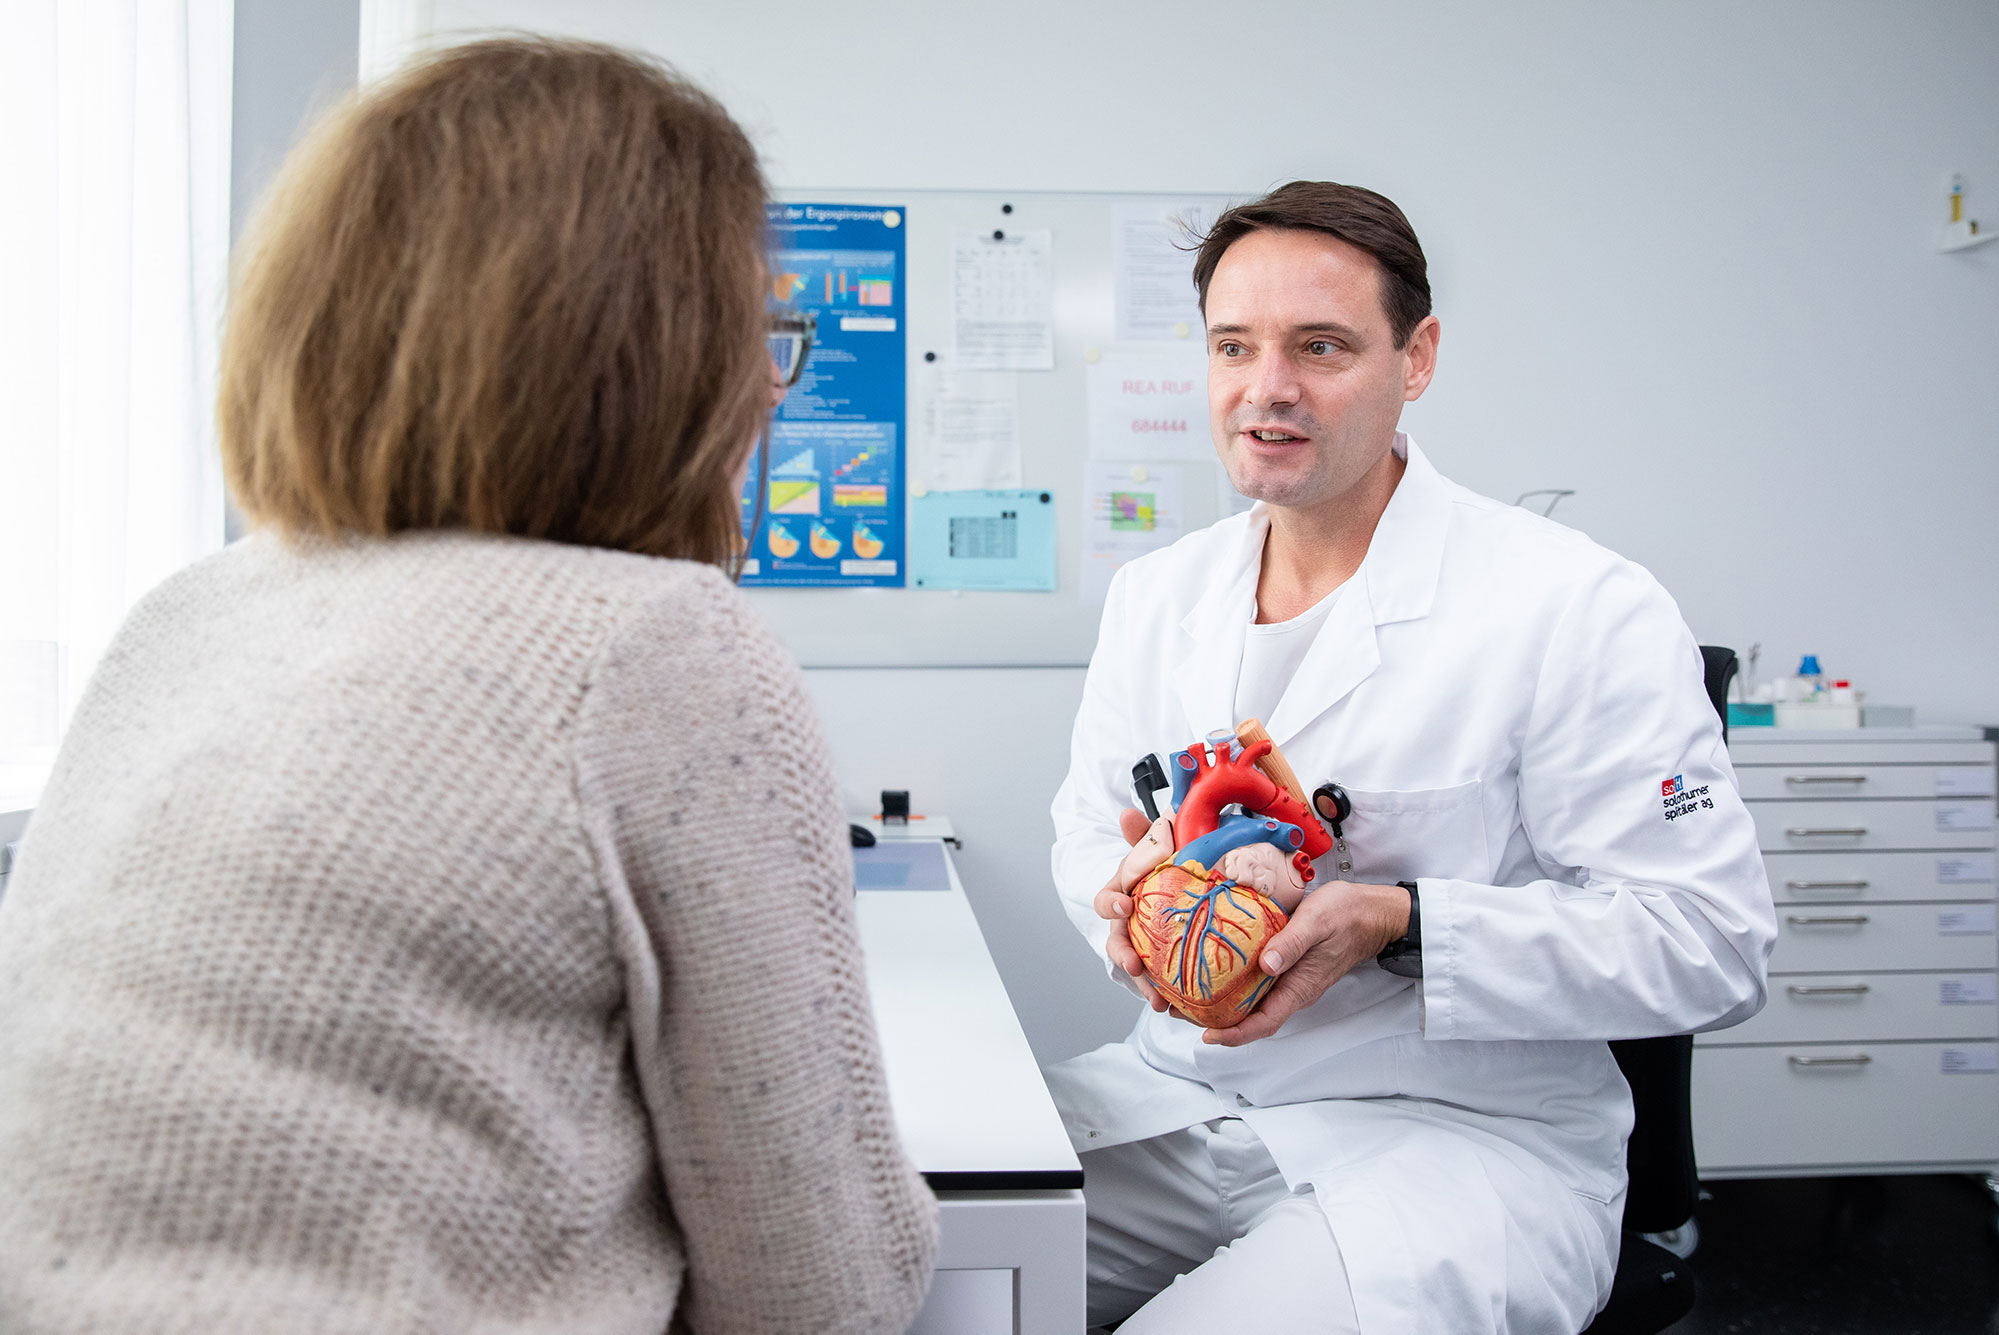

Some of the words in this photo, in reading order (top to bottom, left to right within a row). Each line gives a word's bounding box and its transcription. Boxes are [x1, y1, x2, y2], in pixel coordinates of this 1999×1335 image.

[784, 206, 804, 220] der
[1122, 379, 1157, 395] REA
[1161, 379, 1195, 395] RUF
[1663, 785, 1709, 808] solothurner
[1664, 801, 1698, 821] spitäler
[1700, 797, 1714, 809] ag
